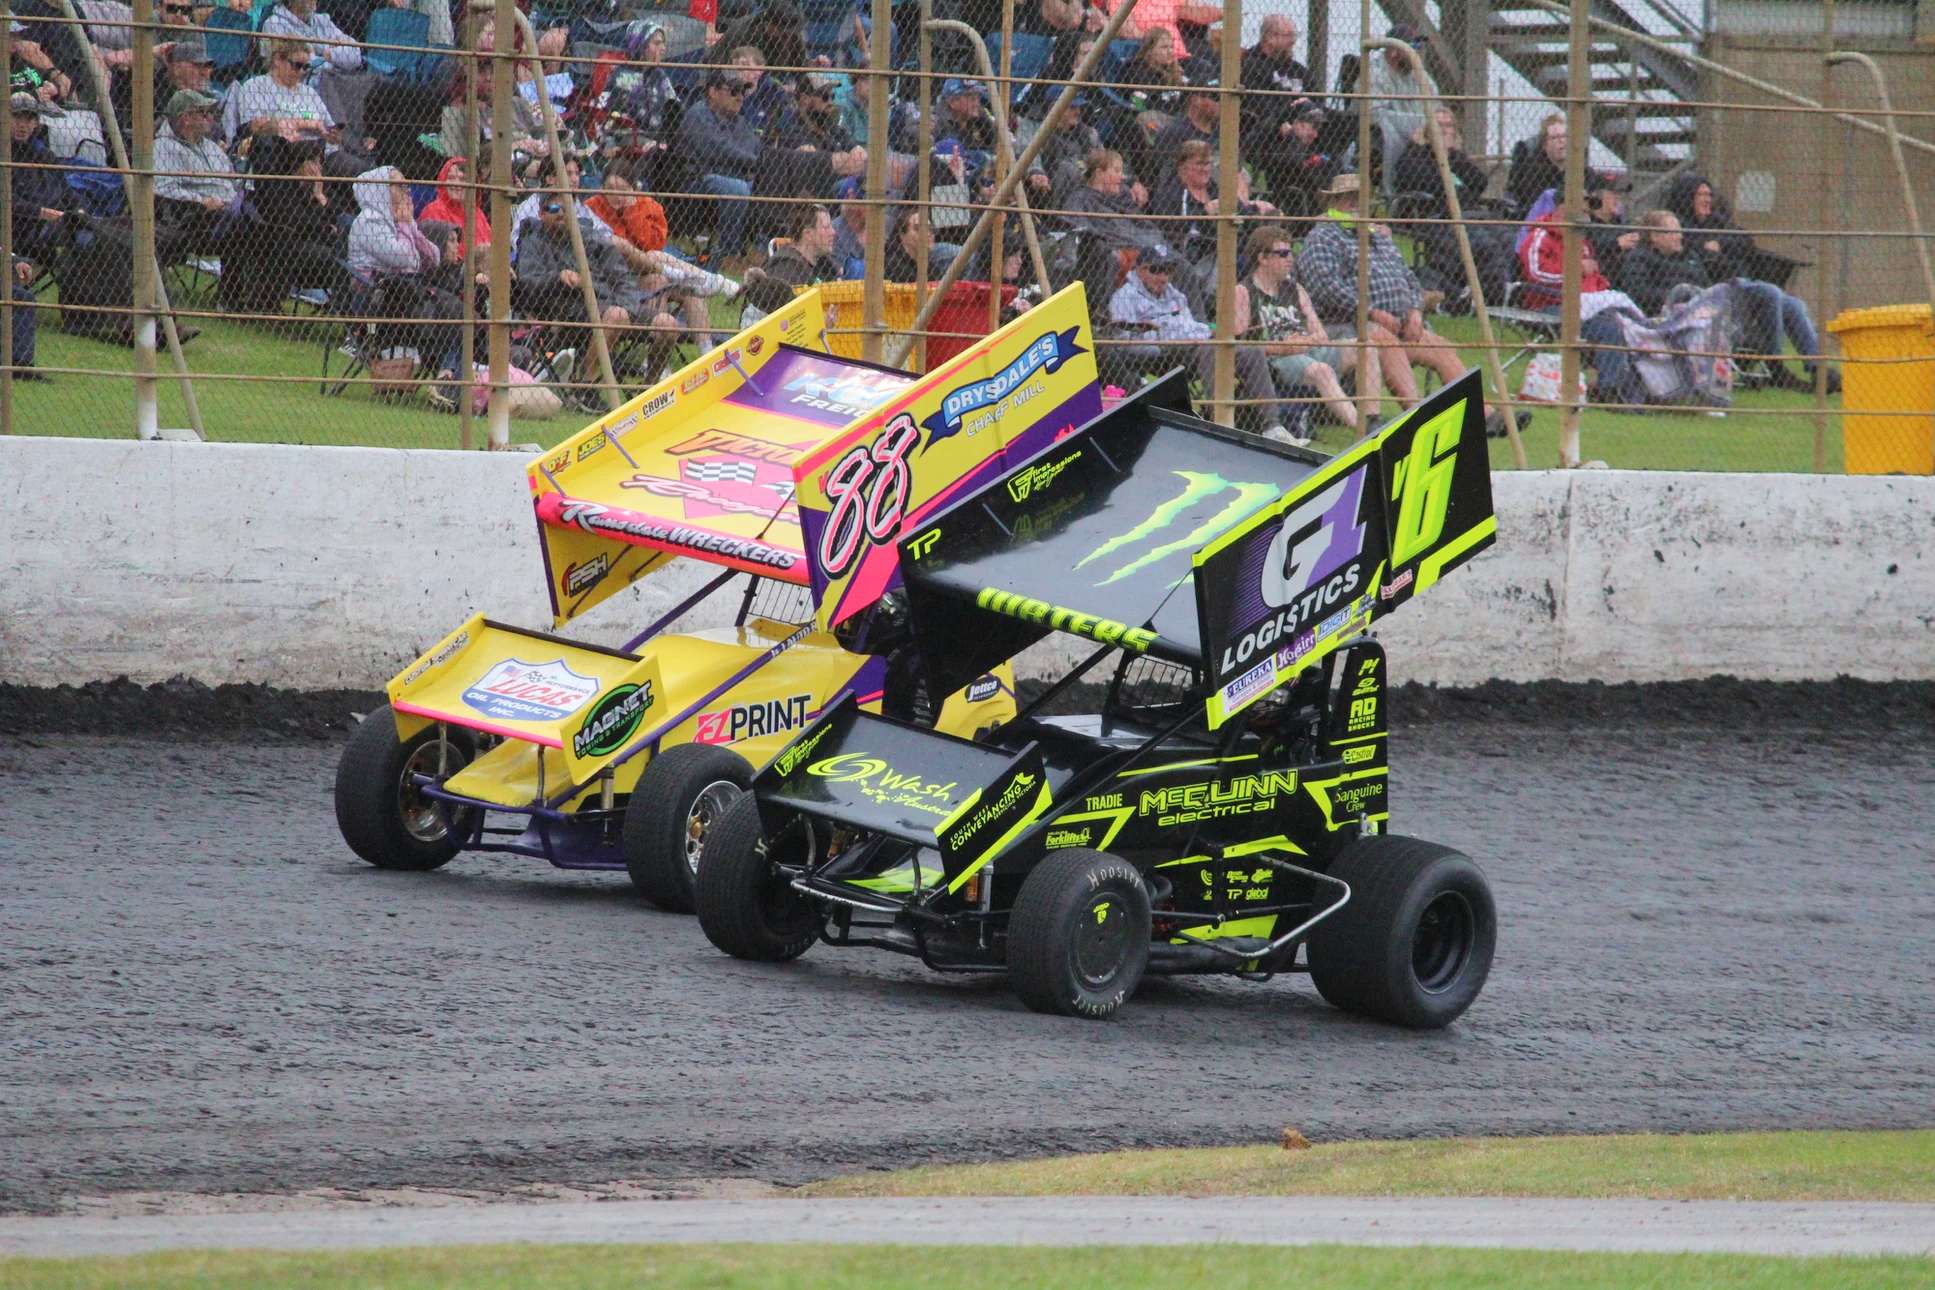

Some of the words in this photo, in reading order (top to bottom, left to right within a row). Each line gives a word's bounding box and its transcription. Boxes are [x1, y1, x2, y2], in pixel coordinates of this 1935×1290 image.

[946, 337, 1055, 415] DRYSDALE'S
[642, 392, 669, 416] CROW
[965, 401, 1009, 437] CHAFF
[1013, 380, 1046, 408] MILL
[818, 412, 921, 581] 88
[667, 526, 797, 569] WRECKERS
[1220, 563, 1361, 676] LOGISTICS
[484, 679, 584, 706] LUCAS
[1232, 661, 1273, 694] EUREKA
[466, 692, 489, 702] OIL
[490, 698, 562, 718] PRODUCTS
[575, 681, 652, 752] MAGNET
[1086, 793, 1123, 812] TRADIE
[1157, 797, 1276, 827] electrical
[1335, 783, 1383, 803] Sanguine
[951, 784, 1022, 852] CONVEYANCING
